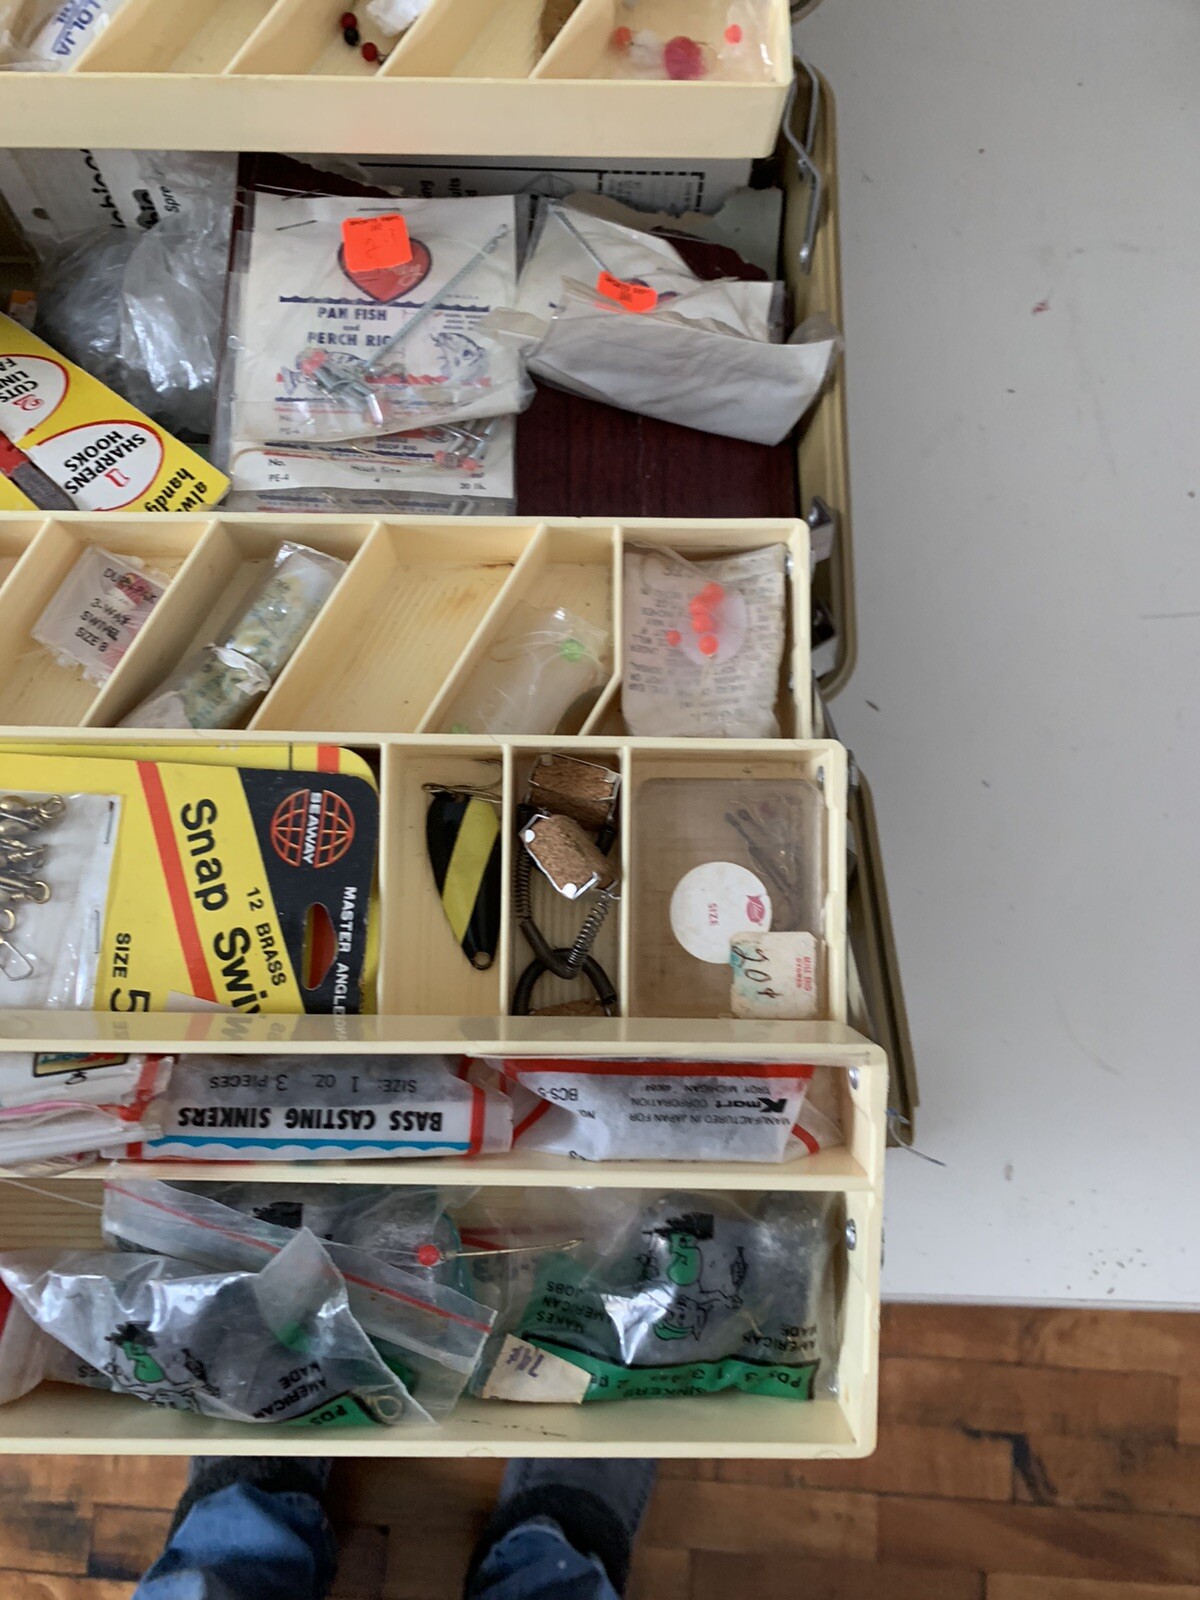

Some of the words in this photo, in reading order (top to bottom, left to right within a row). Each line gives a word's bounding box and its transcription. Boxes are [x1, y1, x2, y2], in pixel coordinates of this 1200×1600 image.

[0, 370, 29, 389] LIN
[63, 430, 125, 472] HOOKS
[65, 433, 147, 495] SHARPENS
[144, 467, 196, 512] handy
[175, 481, 208, 512] alw
[75, 626, 100, 647] SIZE
[181, 798, 229, 911] Snap
[246, 887, 265, 911] 12
[338, 886, 358, 952] MASTER
[707, 902, 719, 926] SIZE
[112, 932, 132, 978] SIZE
[255, 922, 287, 986] BRASS
[110, 987, 151, 1012] 5
[209, 1074, 269, 1089] PIECES
[276, 1074, 289, 1091] 3
[178, 1106, 271, 1128] SINKERS
[285, 1108, 376, 1130] CASTING
[389, 1110, 443, 1132] BASS
